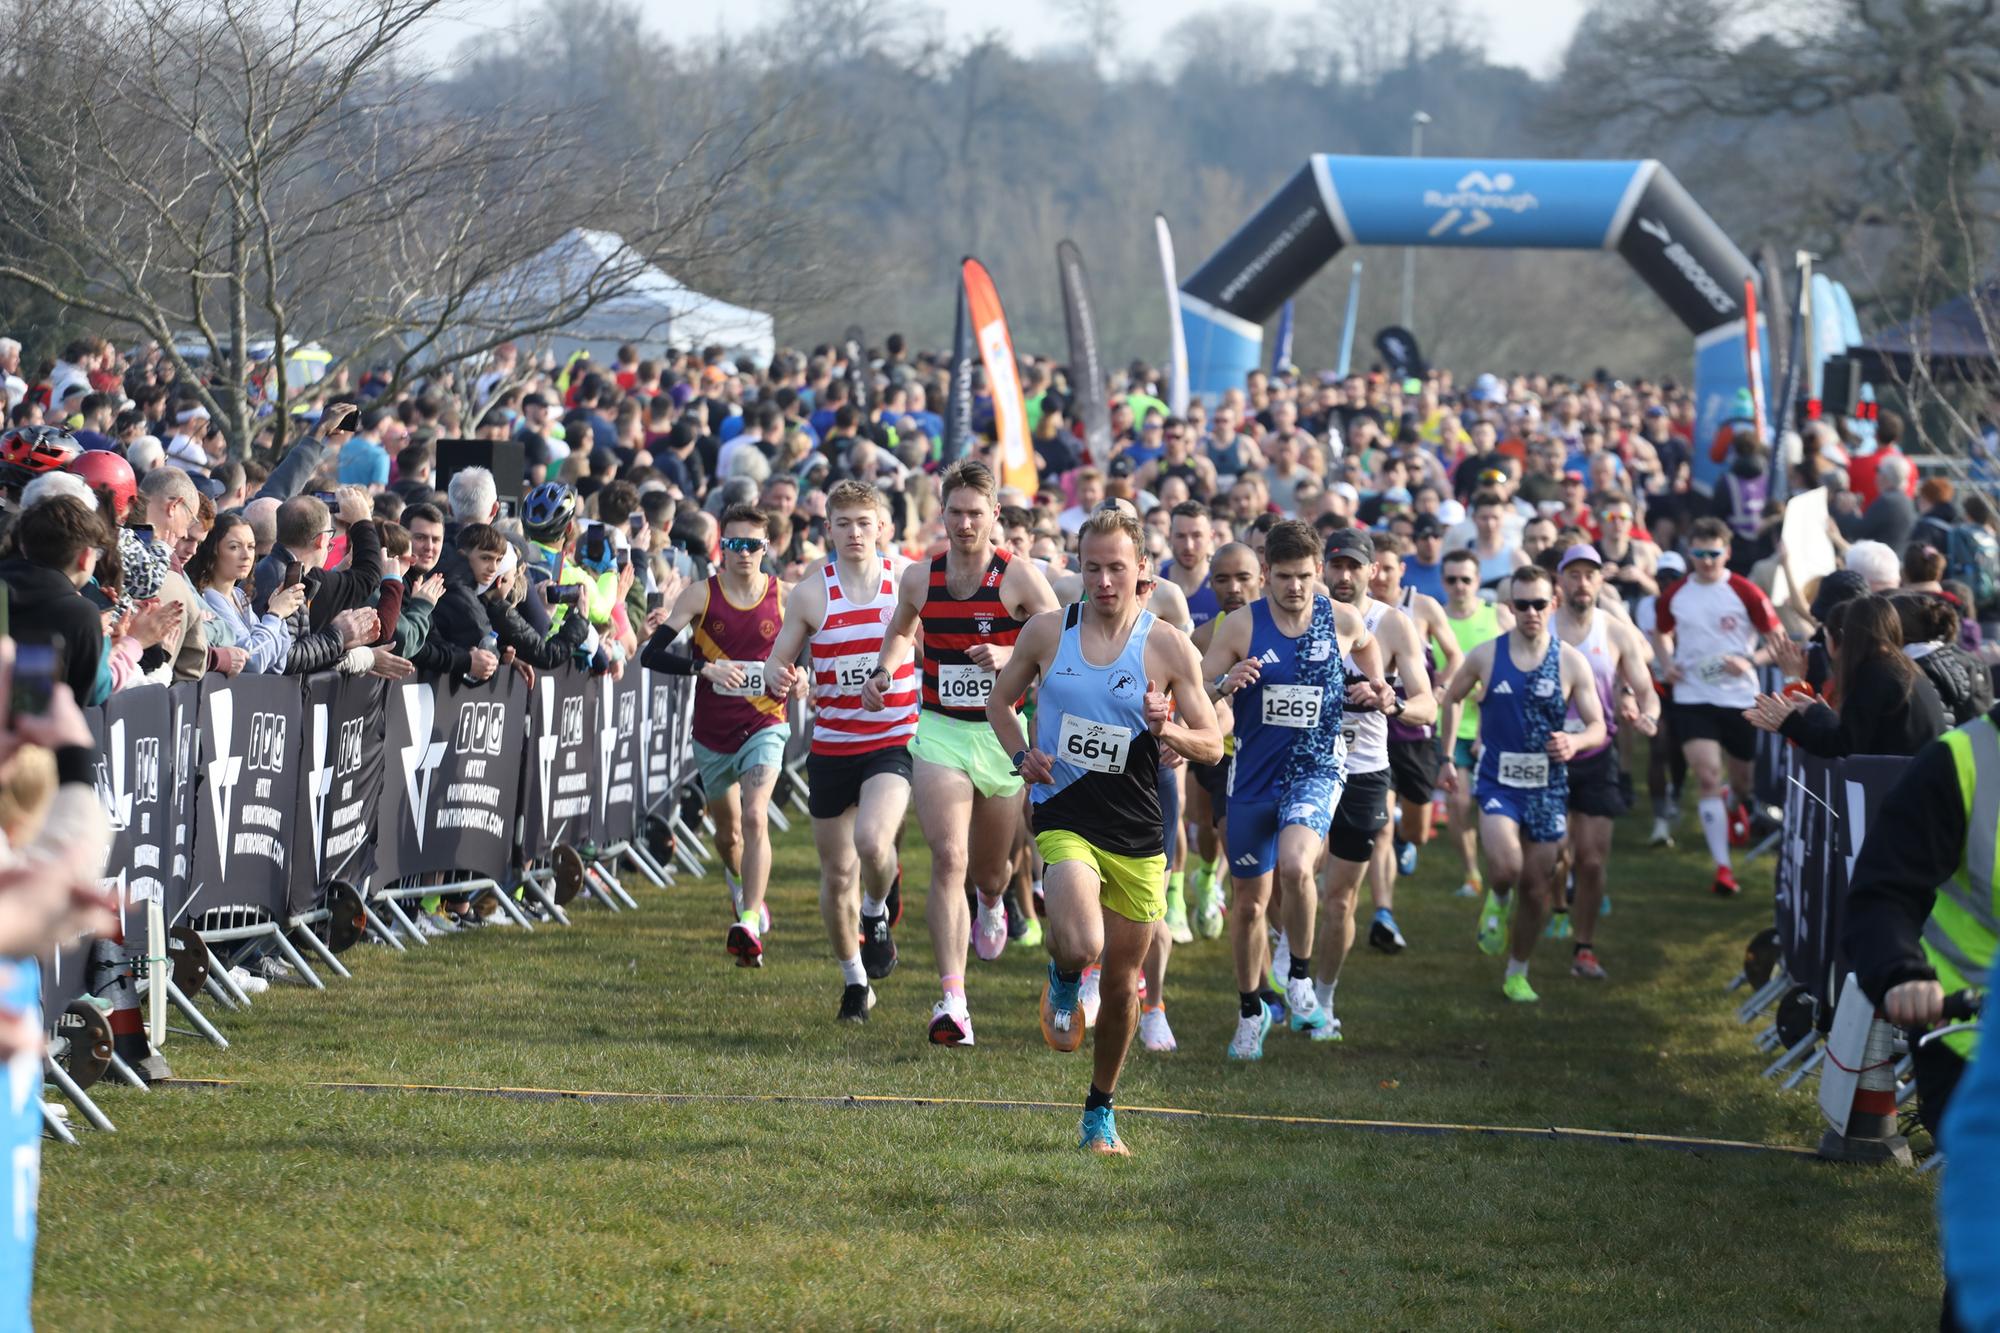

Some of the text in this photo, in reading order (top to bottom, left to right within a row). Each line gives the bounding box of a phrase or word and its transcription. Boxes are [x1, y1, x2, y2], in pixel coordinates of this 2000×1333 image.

[1662, 242, 1738, 314] BROOKS
[942, 679, 993, 697] 1089
[1266, 698, 1318, 718] 1269
[1068, 734, 1118, 762] 664
[1502, 764, 1546, 779] 1262
